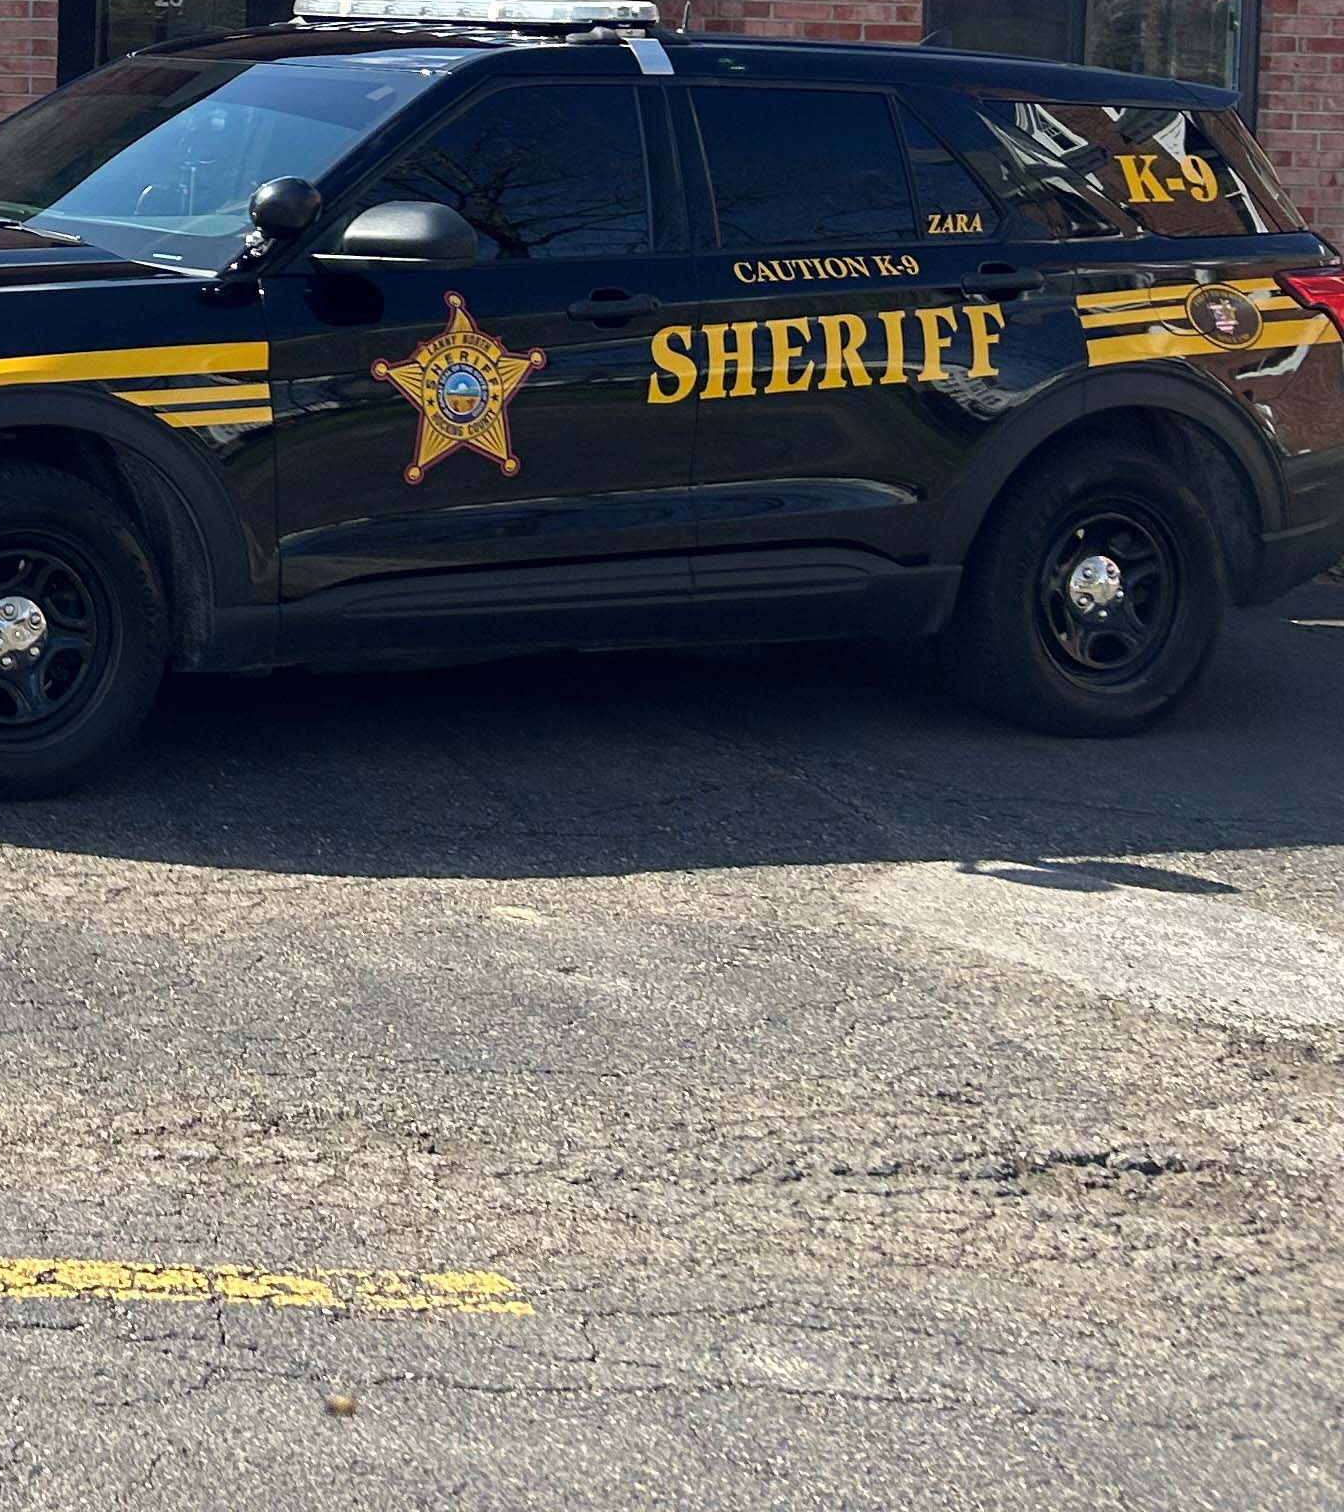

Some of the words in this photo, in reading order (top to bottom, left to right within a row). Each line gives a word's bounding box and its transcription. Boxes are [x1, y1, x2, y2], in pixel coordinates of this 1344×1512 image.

[1115, 153, 1220, 204] K-9
[927, 212, 983, 234] ZARA
[733, 255, 871, 284] CAUTION
[871, 254, 920, 276] K-9
[426, 350, 500, 390] SHERIFF
[646, 303, 1007, 405] SHERIFF
